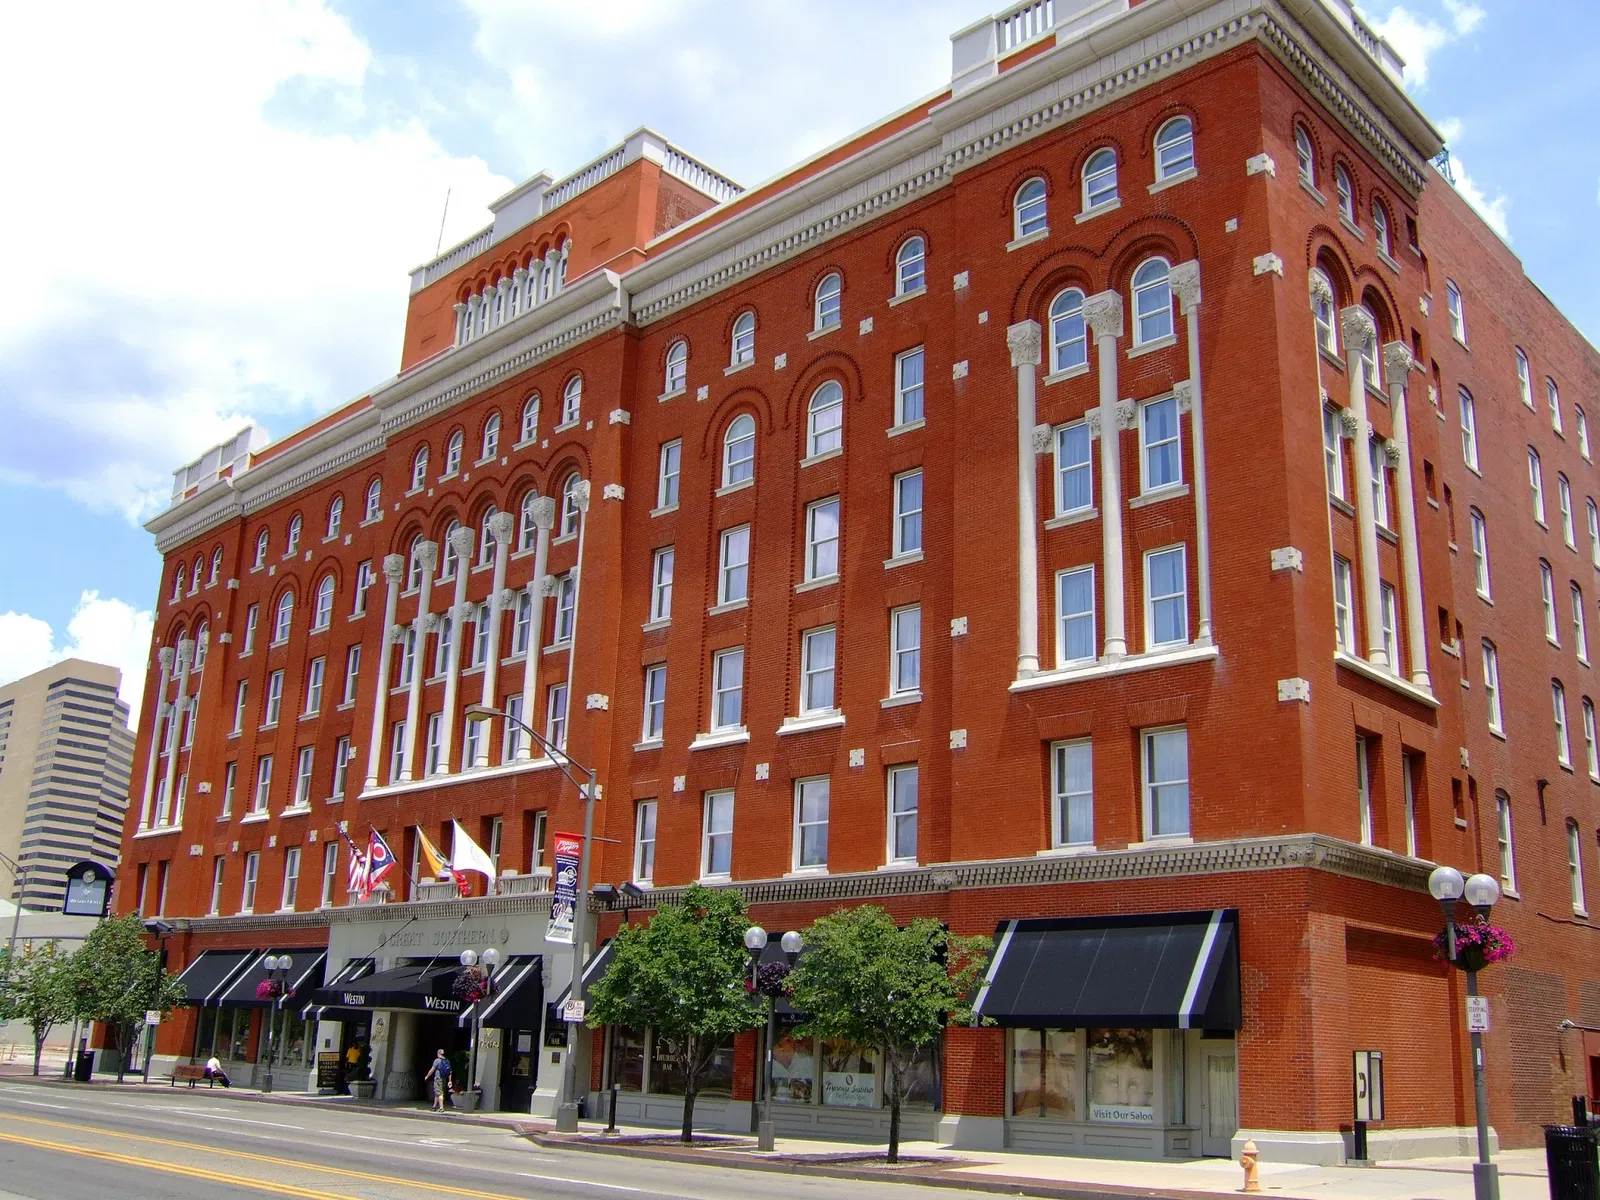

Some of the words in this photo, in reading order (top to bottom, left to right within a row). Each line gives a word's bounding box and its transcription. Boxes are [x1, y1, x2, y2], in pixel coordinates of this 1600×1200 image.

[389, 931, 424, 947] GREAT
[432, 928, 497, 947] SOUTHERN
[343, 992, 365, 1005] WESTIN
[424, 995, 460, 1010] WESTIN
[662, 1063, 673, 1071] BAR
[1093, 1108, 1112, 1119] Visit
[1113, 1110, 1129, 1120] Our
[1130, 1111, 1153, 1121] Salon
